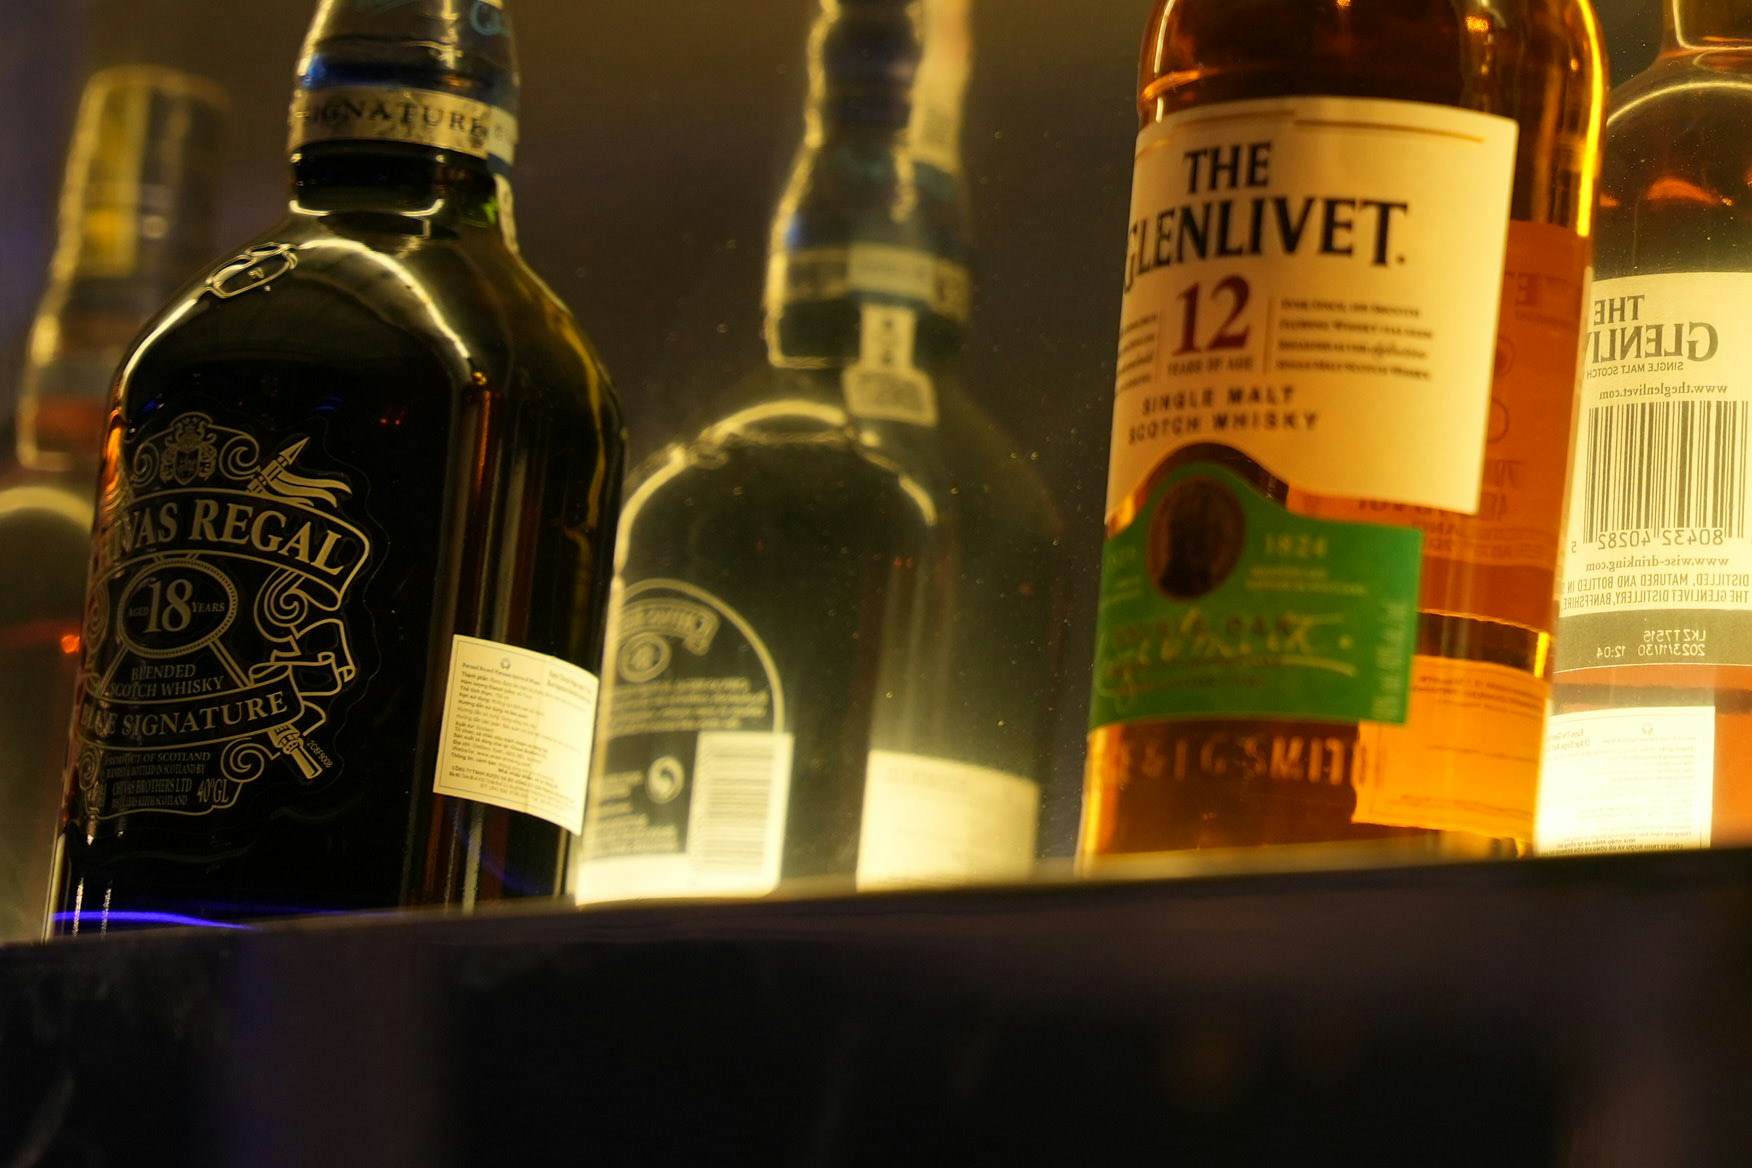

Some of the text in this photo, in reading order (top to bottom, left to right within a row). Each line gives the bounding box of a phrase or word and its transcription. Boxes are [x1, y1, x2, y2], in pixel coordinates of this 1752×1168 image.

[1184, 141, 1273, 194] THE
[1173, 274, 1252, 357] 12
[1142, 385, 1295, 417] SINGLE MALT
[1127, 410, 1320, 446] SCOTCH WHISKY
[187, 498, 345, 576] REGAL
[142, 578, 194, 633] 18
[191, 601, 226, 614] YEARS
[110, 675, 225, 698] SCOTCH WHISKY
[131, 663, 197, 681] BLENDED
[121, 690, 289, 737] SIGNATURE
[143, 752, 155, 764] OF
[158, 751, 211, 763] SCOTLAND
[175, 777, 193, 793] LTD
